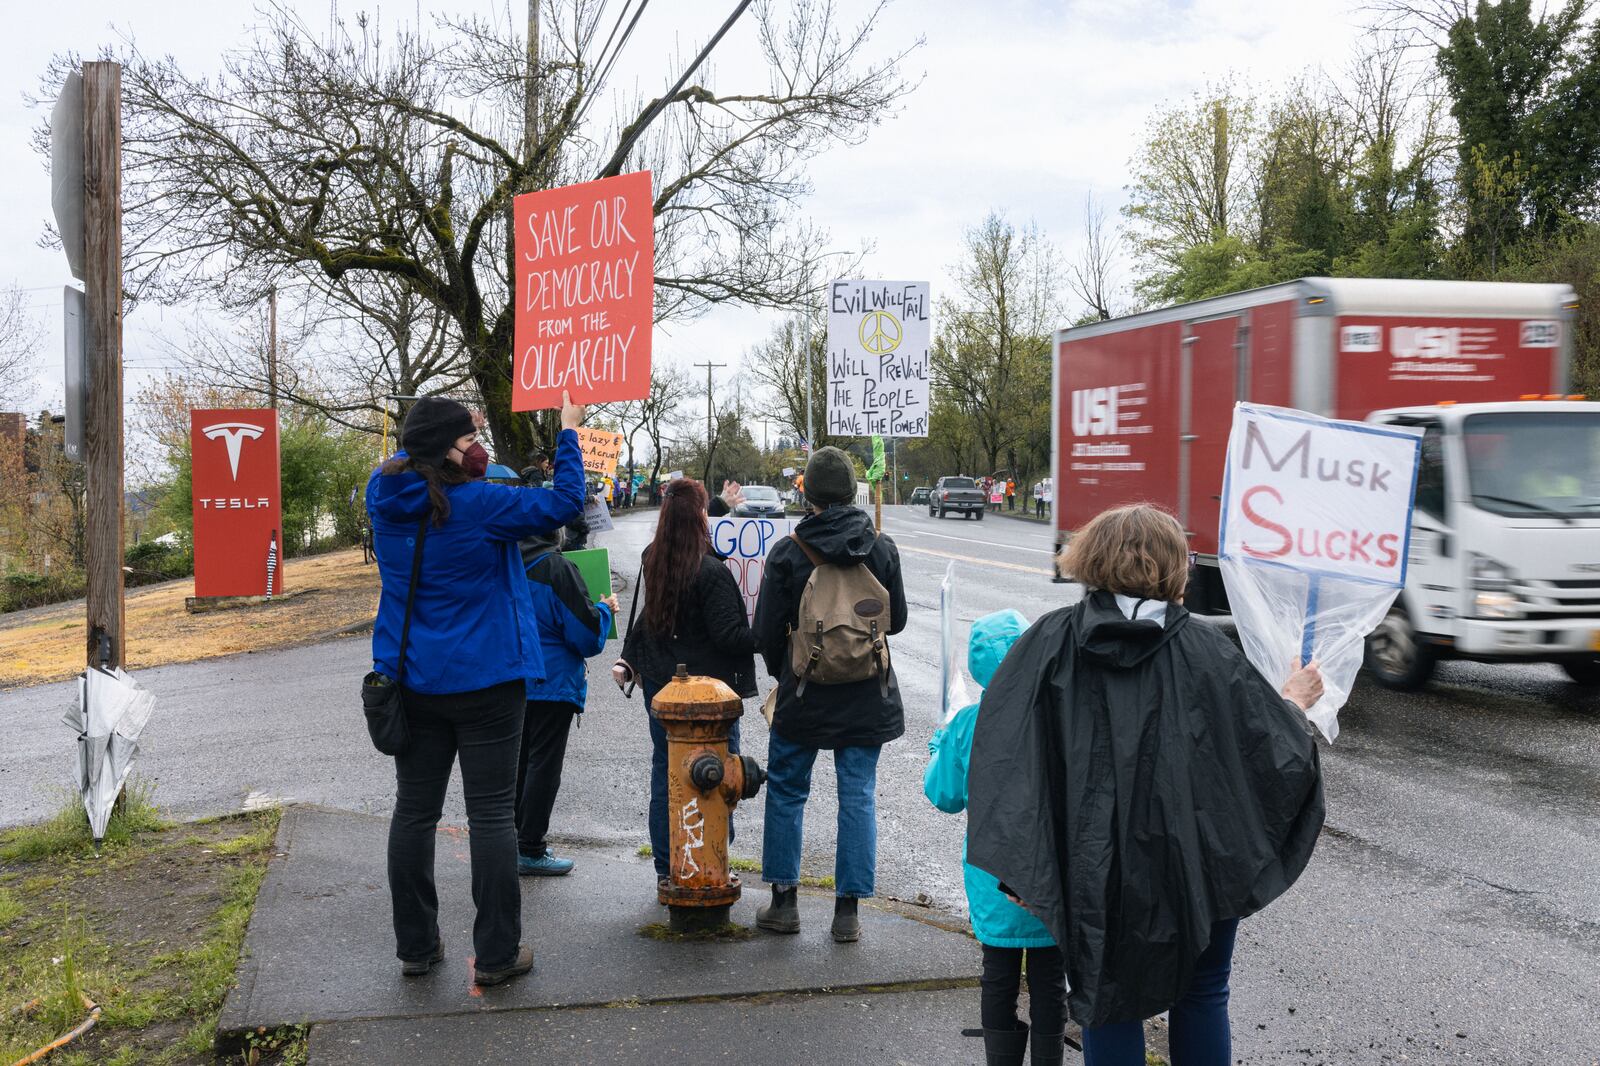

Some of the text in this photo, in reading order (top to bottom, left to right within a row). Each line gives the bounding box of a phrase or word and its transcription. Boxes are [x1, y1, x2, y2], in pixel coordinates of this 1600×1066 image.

[525, 196, 636, 262] SAVE OUR
[526, 251, 640, 312] DEMOCRACY
[538, 311, 611, 338] FROM THE
[520, 325, 636, 391] OLIGARCHY
[830, 378, 920, 410] THE PEOPLE
[589, 433, 611, 446] lazy
[829, 410, 928, 435] HAVE THE POWER!
[583, 460, 607, 471] ssist.
[1241, 420, 1392, 493] Musk
[199, 497, 270, 509] TESLA
[714, 520, 775, 558] GOP
[1241, 485, 1399, 568] Sucks
